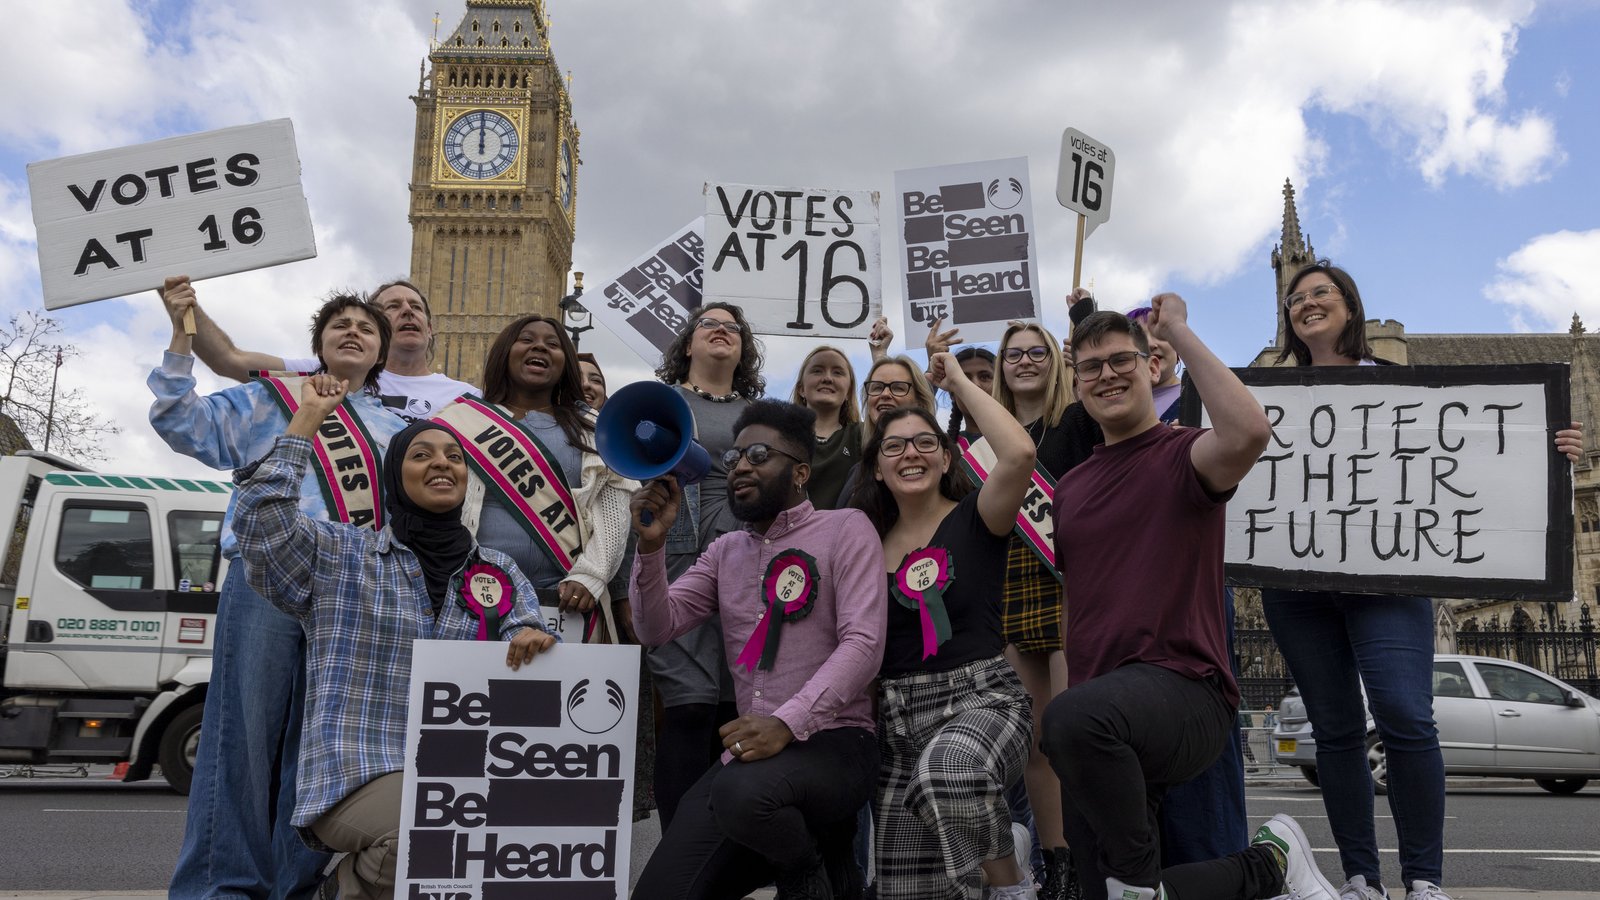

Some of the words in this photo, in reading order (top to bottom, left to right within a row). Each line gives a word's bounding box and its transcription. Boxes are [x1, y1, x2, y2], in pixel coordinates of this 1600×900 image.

[1070, 136, 1096, 157] votes
[1097, 149, 1107, 163] at
[67, 152, 262, 213] VOTES
[1072, 152, 1104, 212] 16
[716, 186, 854, 238] VOTES
[903, 191, 944, 217] Be
[73, 228, 153, 276] AT
[197, 206, 266, 252] 16
[945, 213, 1026, 240] Seen
[637, 255, 676, 291] Be
[906, 246, 949, 272] Be
[712, 231, 777, 272] AT
[781, 240, 870, 330] 16
[933, 262, 1030, 297] Heard
[1262, 400, 1523, 457] ROTECT
[474, 425, 545, 498] VOTES
[539, 499, 576, 534] AT
[1257, 451, 1477, 506] THEIR
[348, 508, 377, 532] A
[1245, 507, 1485, 564] FUTURE
[474, 576, 497, 584] VOTES
[788, 569, 804, 583] VOTES
[911, 560, 934, 573] VOTES
[917, 576, 930, 588] 16
[919, 570, 928, 578] AT
[480, 592, 494, 604] 16
[780, 586, 792, 599] 16
[57, 618, 86, 630] 020
[89, 619, 128, 632] 8887
[130, 620, 160, 632] 0101
[547, 614, 565, 632] at
[421, 681, 490, 726] Be
[486, 731, 621, 778] Seen
[414, 782, 487, 828] Be
[454, 829, 617, 879] Heard
